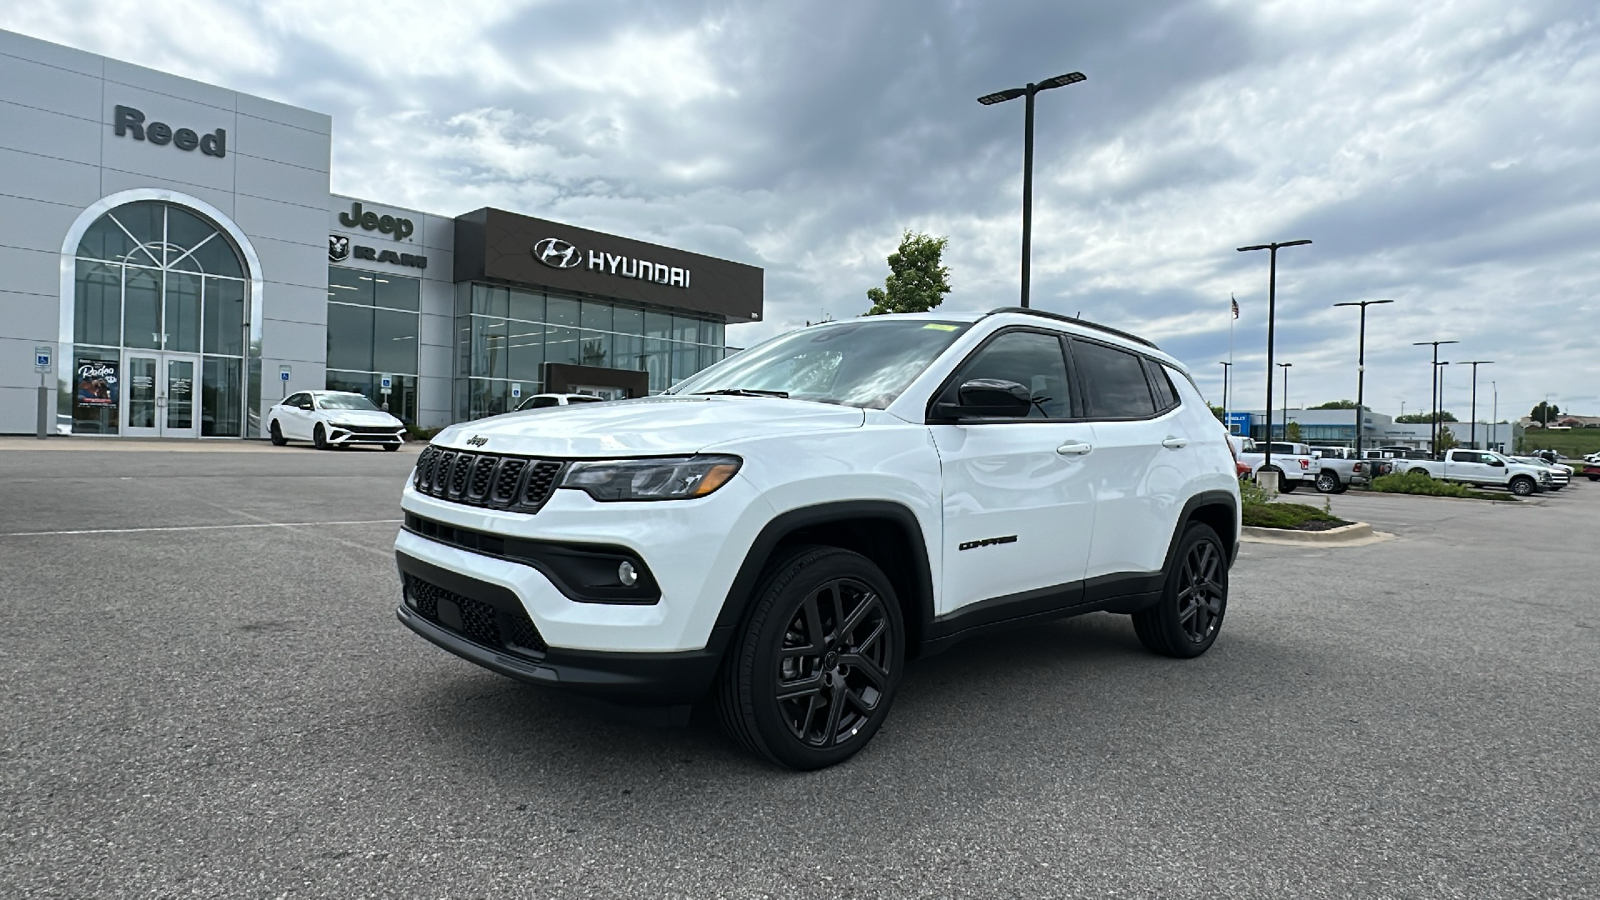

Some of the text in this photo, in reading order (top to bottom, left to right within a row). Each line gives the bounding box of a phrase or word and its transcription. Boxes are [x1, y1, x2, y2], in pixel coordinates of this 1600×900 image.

[114, 104, 226, 158] Reed
[339, 202, 414, 242] Jeep
[353, 245, 428, 269] RAM
[588, 249, 690, 289] HYUNDAI
[78, 364, 114, 379] Rodeo
[958, 534, 1018, 551] COMPASS
